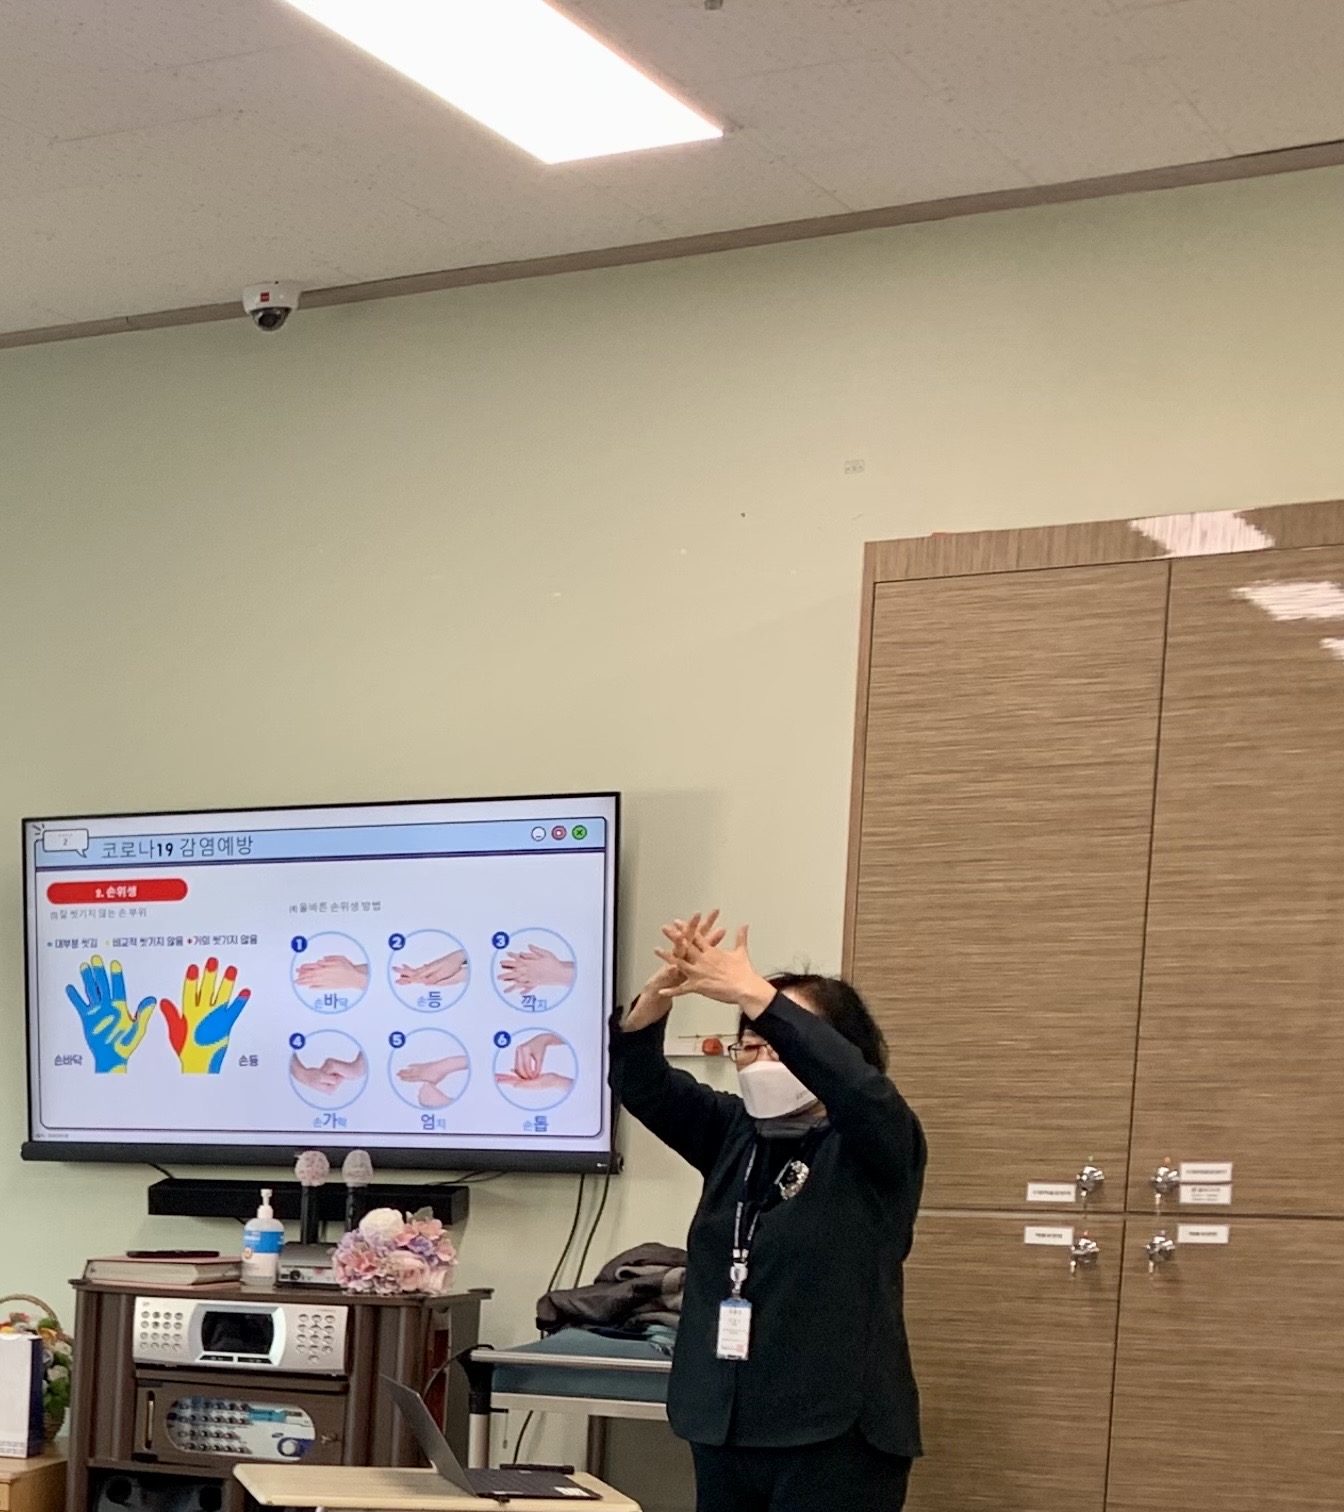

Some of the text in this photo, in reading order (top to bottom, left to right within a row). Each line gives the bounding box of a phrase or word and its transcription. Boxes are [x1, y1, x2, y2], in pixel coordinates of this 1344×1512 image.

[101, 836, 253, 859] 코로나19 감염예방
[330, 901, 359, 913] 손위생
[54, 1055, 83, 1067] 손바닥
[238, 1054, 260, 1067] 손등
